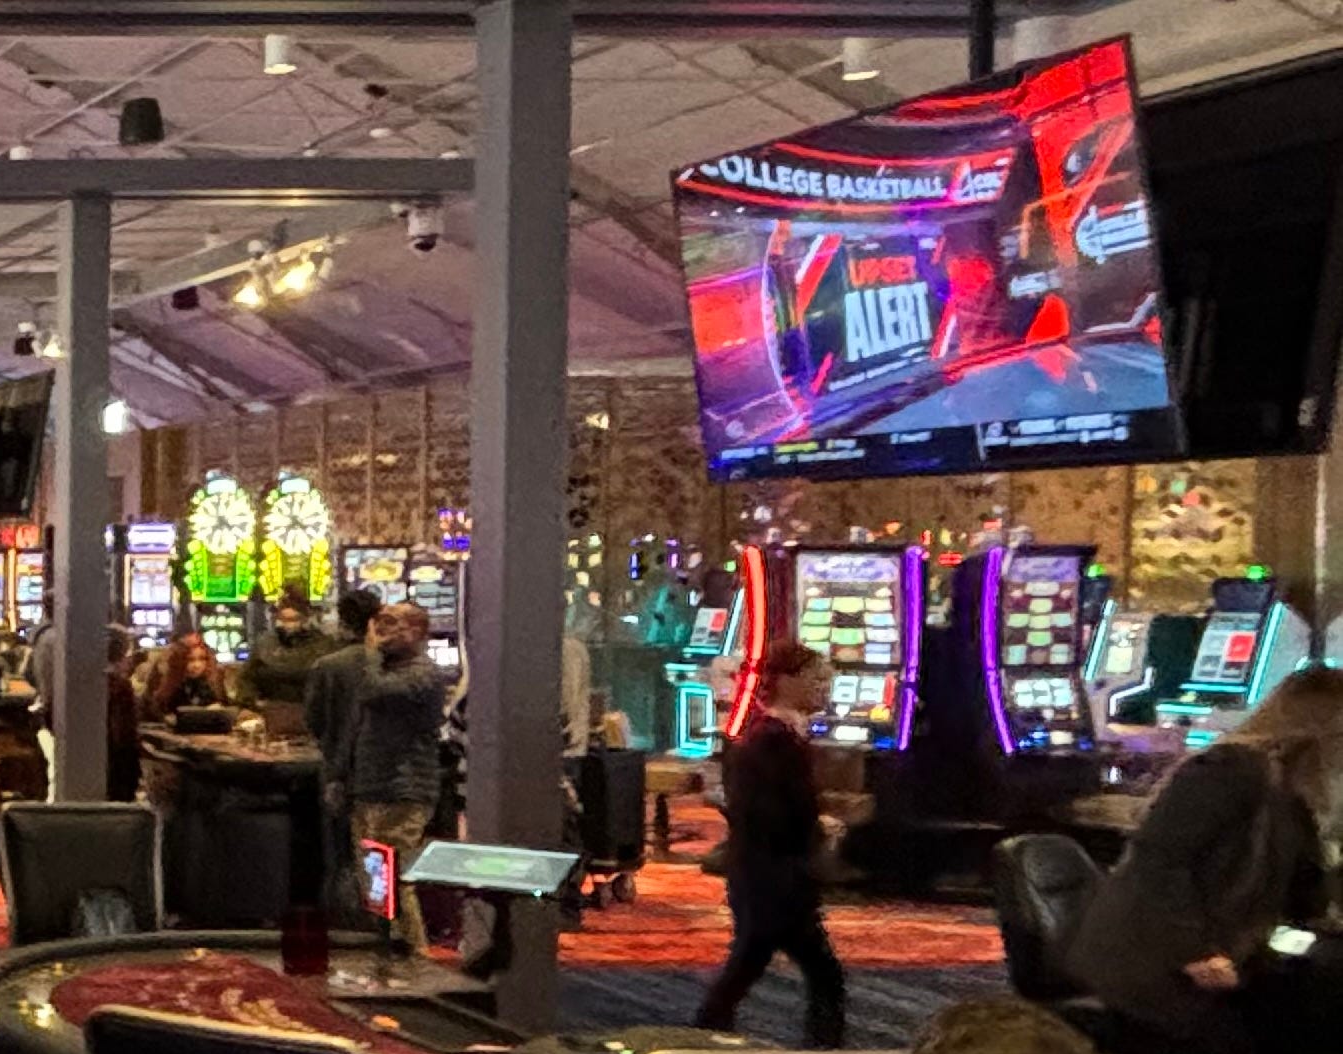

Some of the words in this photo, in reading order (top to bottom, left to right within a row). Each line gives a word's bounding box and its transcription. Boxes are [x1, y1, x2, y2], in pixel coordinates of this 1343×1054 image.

[826, 173, 946, 199] BASKETBALL
[849, 256, 916, 287] UPSET
[845, 281, 932, 363] ALERT
